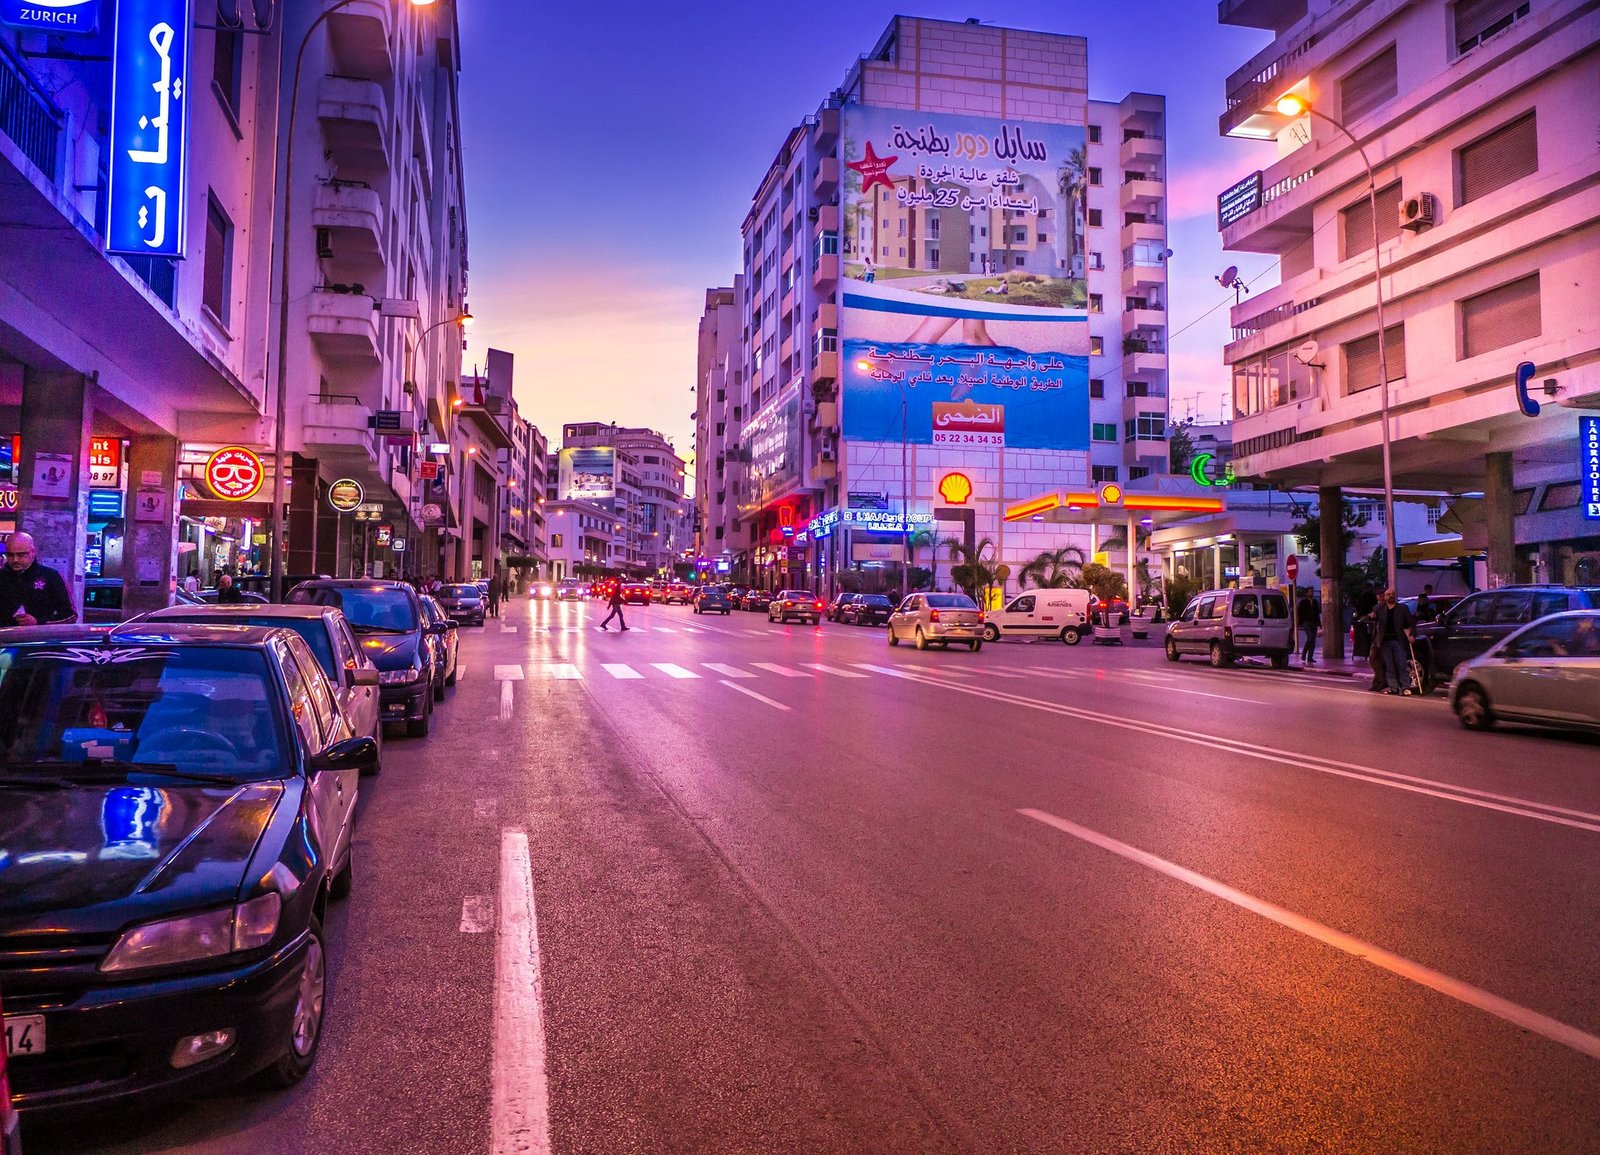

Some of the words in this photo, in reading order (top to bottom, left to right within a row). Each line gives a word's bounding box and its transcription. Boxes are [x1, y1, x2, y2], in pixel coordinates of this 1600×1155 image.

[20, 9, 77, 24] ZURICH
[955, 132, 989, 160] دور
[995, 125, 1047, 162] سابل
[920, 165, 956, 183] الجودة
[959, 167, 988, 182] عالية
[992, 171, 1020, 187] شقق
[897, 186, 932, 206] مليون
[934, 189, 960, 206] 25
[962, 195, 985, 211] من
[868, 346, 934, 364] بطنجة
[938, 353, 984, 366] البحر
[987, 353, 1036, 370] واجهة
[1038, 358, 1064, 372] على
[909, 371, 932, 387] نادي
[935, 375, 954, 387] بعد
[991, 375, 1027, 388] الوطنية
[1030, 378, 1062, 391] الطريق
[936, 408, 1001, 427] الضحى
[934, 434, 946, 443] 05
[949, 434, 960, 443] 22
[963, 435, 974, 444] 34
[977, 435, 988, 444] 34
[991, 436, 1003, 444] 35
[1588, 419, 1600, 502] LABORATOIRE
[102, 472, 114, 481] 97
